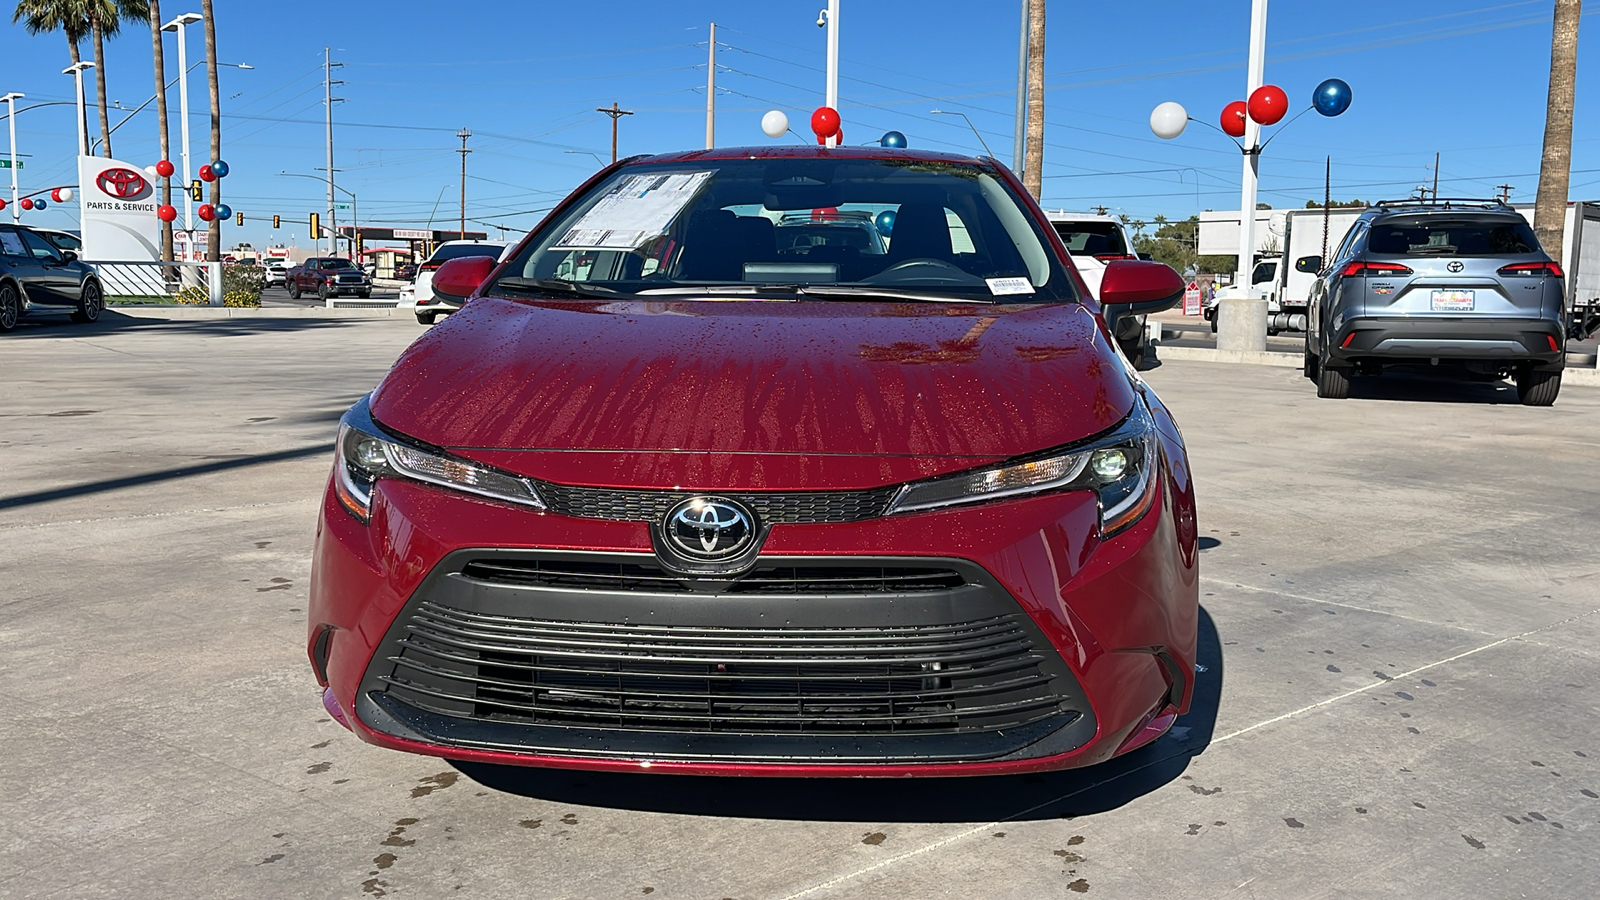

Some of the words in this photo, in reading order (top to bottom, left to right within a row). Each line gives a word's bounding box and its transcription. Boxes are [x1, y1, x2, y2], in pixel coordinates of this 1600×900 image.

[86, 201, 113, 210] PARTS
[114, 202, 121, 210] &
[122, 203, 154, 212] SERVICE
